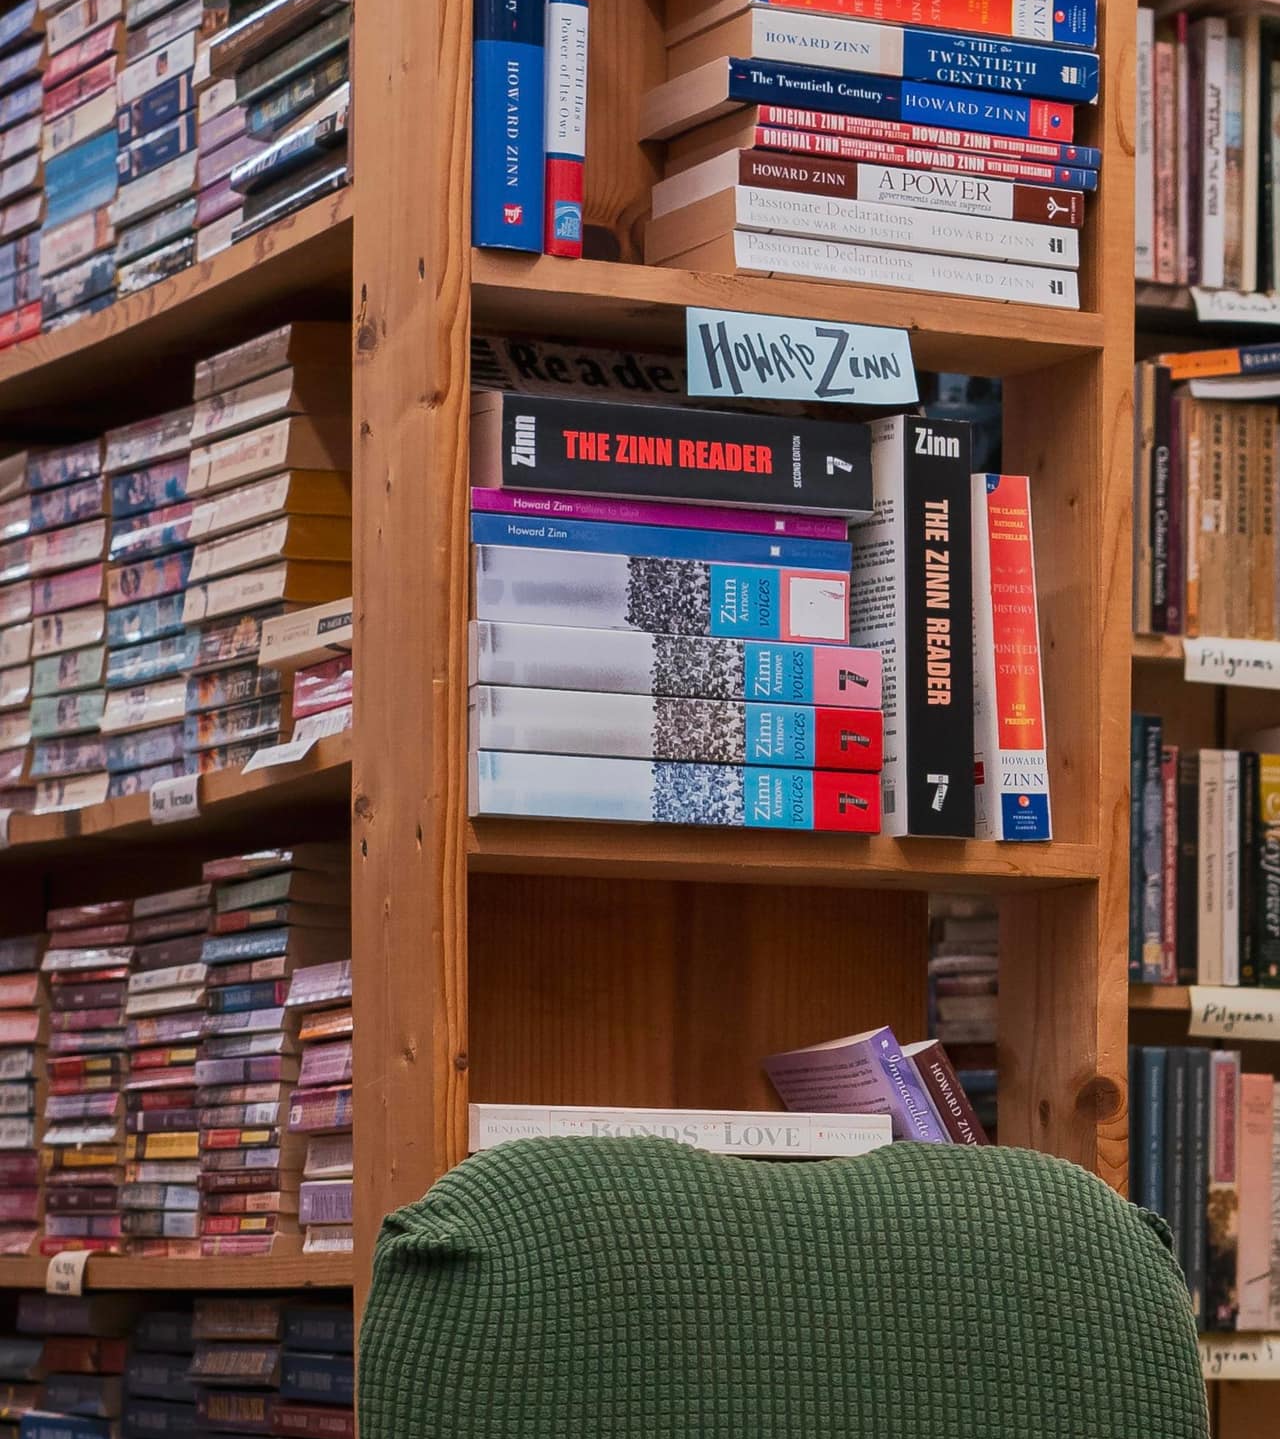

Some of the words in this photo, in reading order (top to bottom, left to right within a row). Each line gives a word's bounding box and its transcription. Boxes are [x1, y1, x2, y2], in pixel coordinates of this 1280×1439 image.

[766, 31, 831, 51] HOWARD
[834, 40, 871, 55] ZINN
[968, 41, 998, 54] THE
[927, 48, 1037, 75] TWENTIETH
[936, 68, 1028, 92] CENTURY
[507, 60, 520, 138] HOWARD
[905, 94, 979, 116] HOWARD
[984, 106, 1027, 123] ZINN
[769, 107, 817, 129] ORIGINAL
[820, 112, 845, 131] ZINN
[912, 127, 959, 148] HOWARD
[963, 132, 991, 151] ZINN
[506, 141, 519, 188] ZINN
[752, 163, 809, 181] HOWARD
[812, 170, 845, 186] ZINN
[878, 170, 895, 190] A
[902, 173, 992, 203] POWER
[748, 191, 822, 218] Passionate
[825, 200, 914, 227] Declarations
[504, 341, 690, 395] Reade
[511, 415, 536, 468] Zinn
[563, 430, 610, 462] THE
[615, 433, 677, 468] ZINN
[679, 439, 773, 475] READER
[792, 435, 801, 458] EDITION
[914, 426, 960, 459] Zinn
[793, 458, 802, 488] SECOND
[513, 497, 551, 513] Howard
[553, 500, 574, 513] Zinn
[924, 498, 949, 543] THE
[925, 550, 949, 610] ZINN
[720, 578, 737, 624] Zinn
[740, 582, 749, 622] Arnove
[758, 578, 771, 627] voices
[926, 617, 952, 707] READER
[1001, 755, 1045, 767] HOWARD
[1003, 772, 1045, 787] ZINN
[888, 1052, 931, 1138] Immaculate
[929, 1062, 965, 1122] HOWARD
[487, 1124, 543, 1136] BENJAMIN
[724, 1120, 801, 1147] LOVE
[826, 1131, 884, 1142] PANTHEON
[1200, 1345, 1258, 1372] ilgrims
